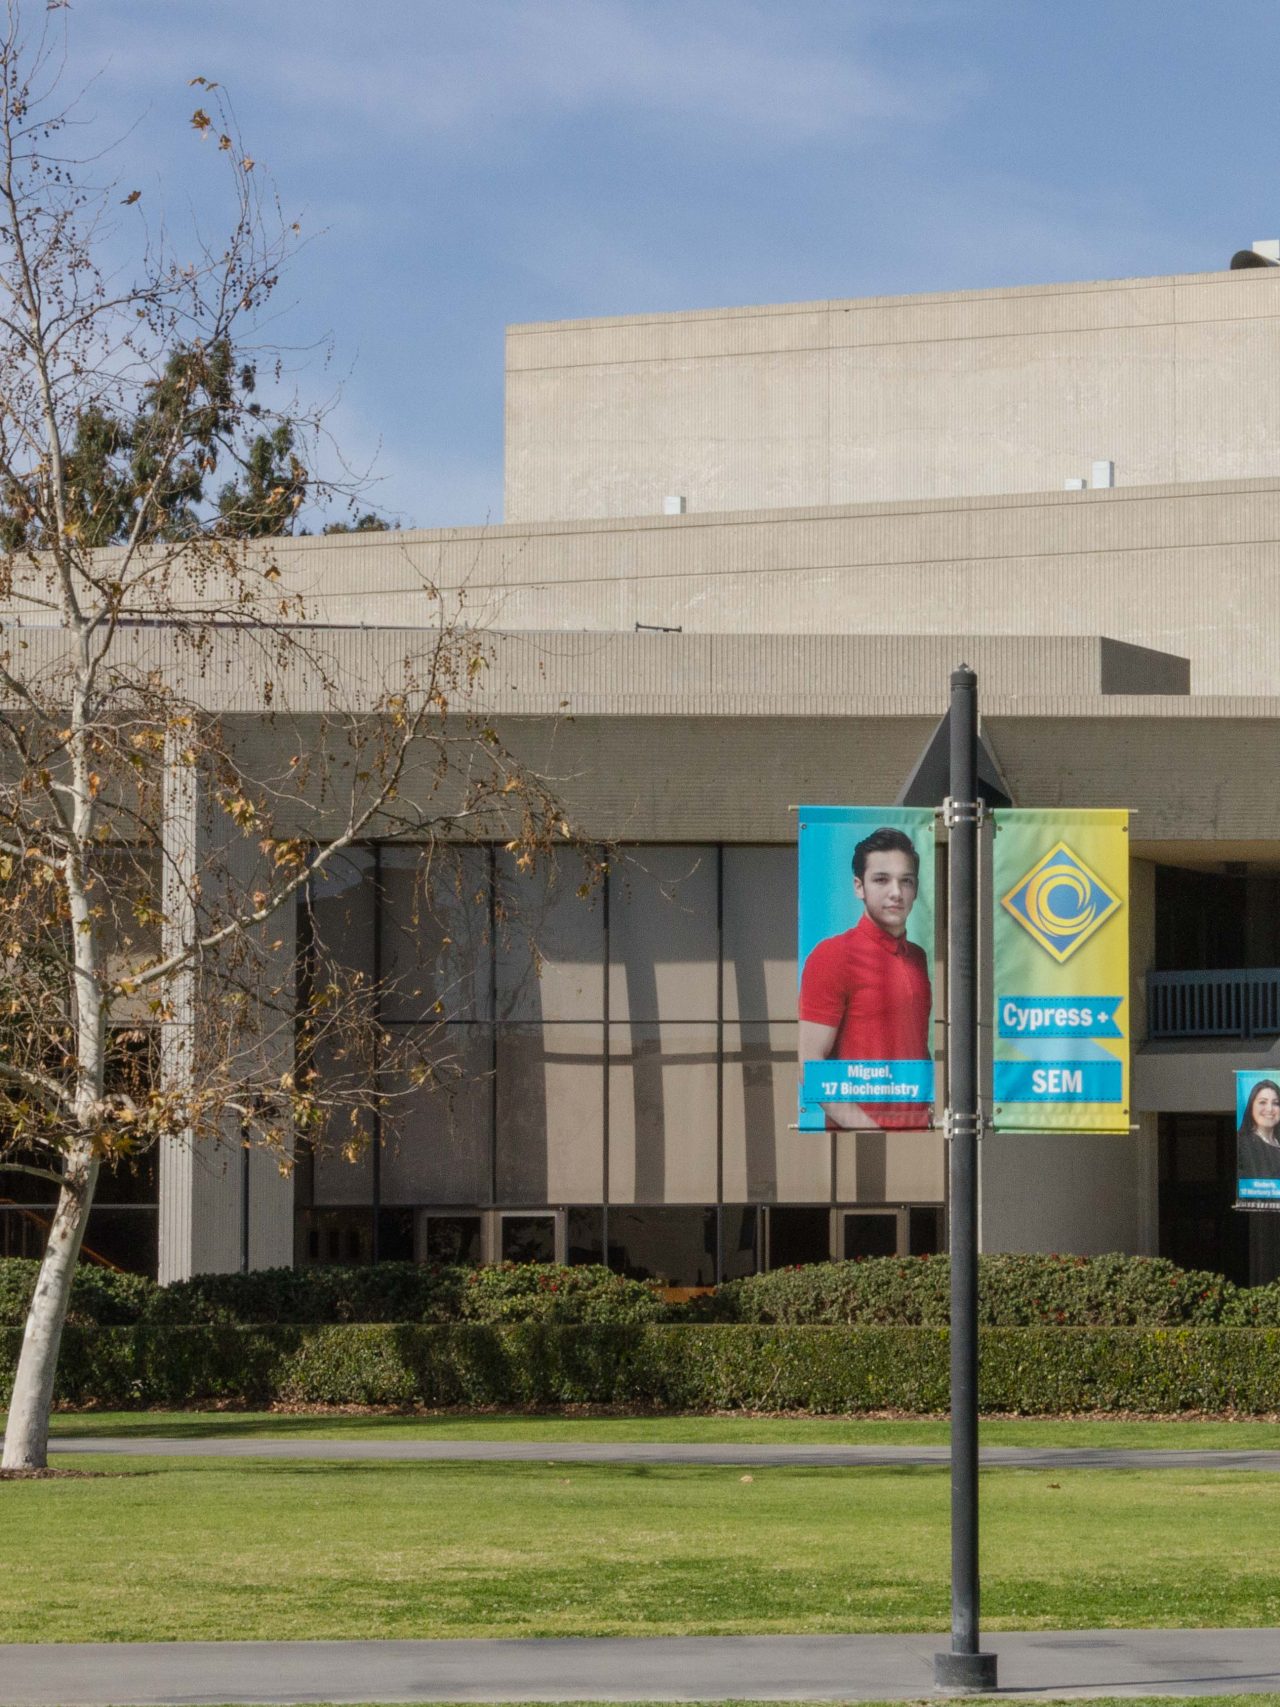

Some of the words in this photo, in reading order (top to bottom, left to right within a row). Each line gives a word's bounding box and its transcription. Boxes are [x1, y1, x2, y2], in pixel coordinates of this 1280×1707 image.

[1003, 1003, 1093, 1031] Cypress
[847, 1065, 893, 1080] Miguel,
[1032, 1069, 1082, 1093] SEM
[821, 1082, 838, 1096] '17
[841, 1082, 919, 1098] Biochemistry
